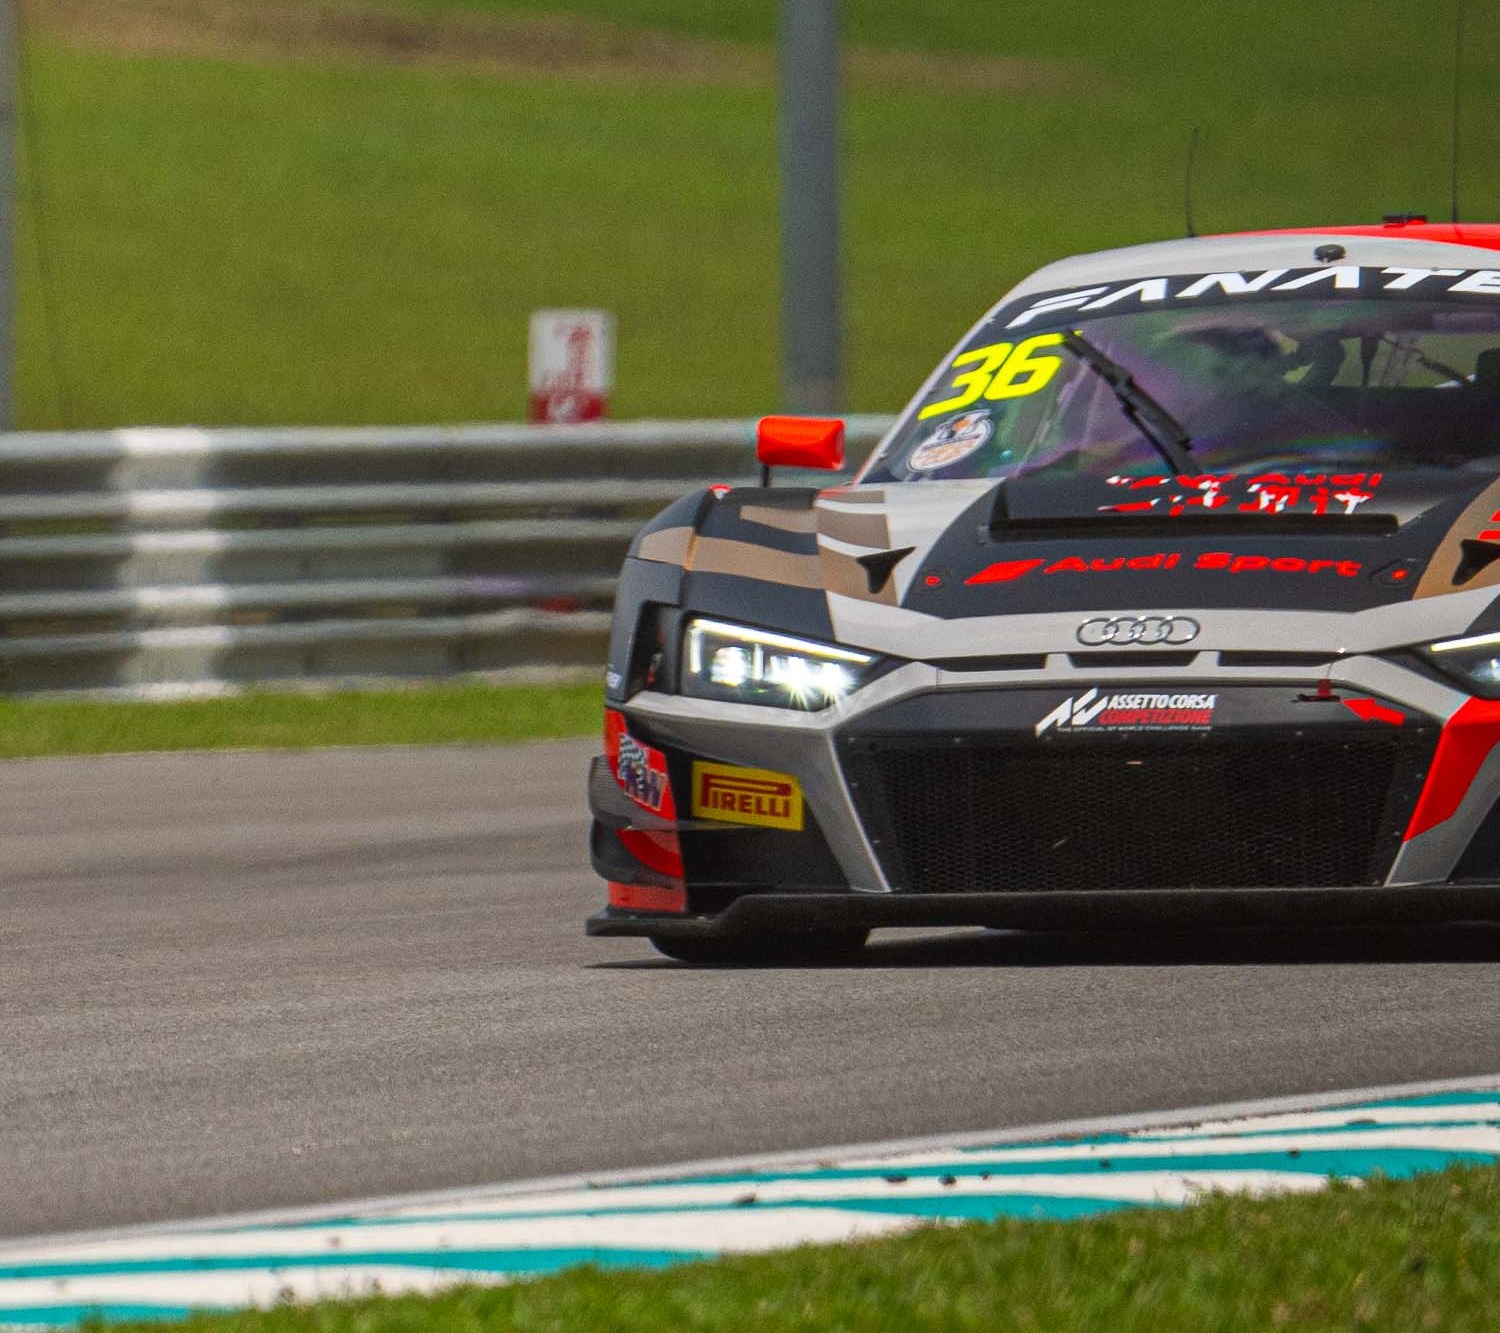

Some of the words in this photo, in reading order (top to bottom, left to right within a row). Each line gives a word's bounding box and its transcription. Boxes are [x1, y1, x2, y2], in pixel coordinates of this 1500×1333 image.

[918, 332, 1083, 421] 36
[1044, 552, 1181, 573] Audi
[1194, 552, 1363, 577] Sport
[1108, 694, 1169, 709] ASSETTO
[1168, 694, 1217, 710] CORSA
[1098, 709, 1214, 725] COMPETIZIONE
[701, 772, 793, 818] PIRELLI
